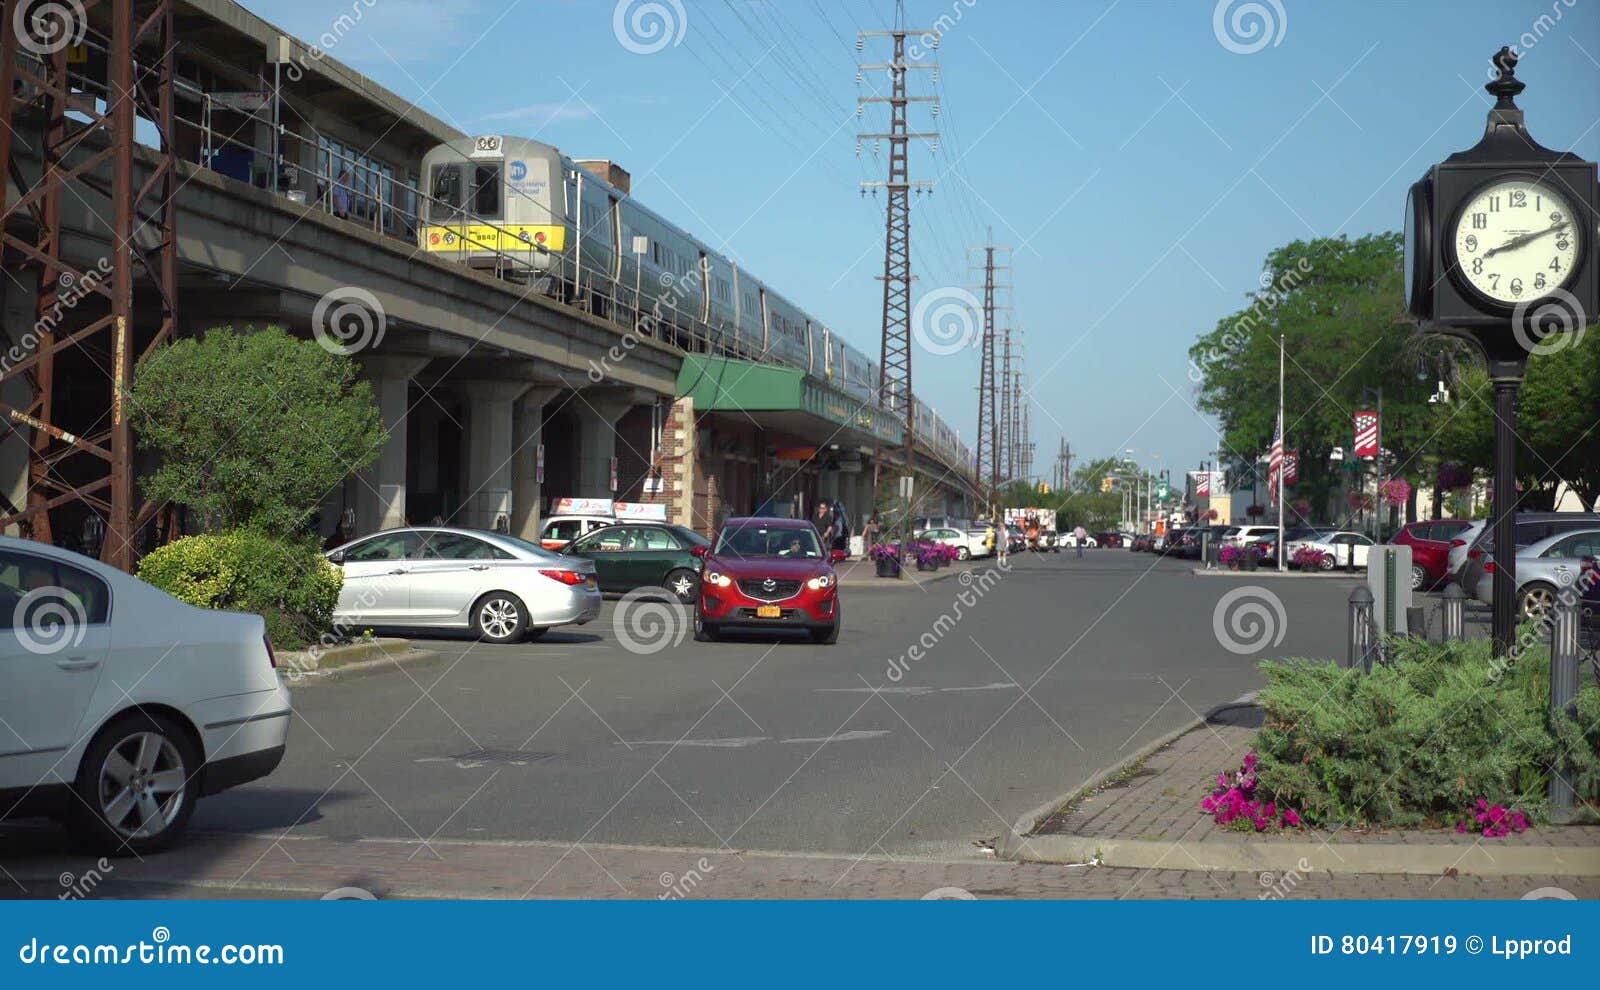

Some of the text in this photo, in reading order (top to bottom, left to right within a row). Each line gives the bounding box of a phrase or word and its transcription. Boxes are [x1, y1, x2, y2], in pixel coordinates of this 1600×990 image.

[1489, 196, 1500, 212] 11
[1509, 190, 1527, 208] 12
[1536, 195, 1541, 212] 1
[1472, 212, 1487, 229] 10
[1465, 234, 1478, 253] 9
[1555, 232, 1569, 251] 3
[1472, 257, 1483, 275] 8
[1549, 256, 1562, 273] 4
[1487, 273, 1501, 290] 7
[1510, 277, 1523, 296] 6
[1534, 272, 1546, 290] 5
